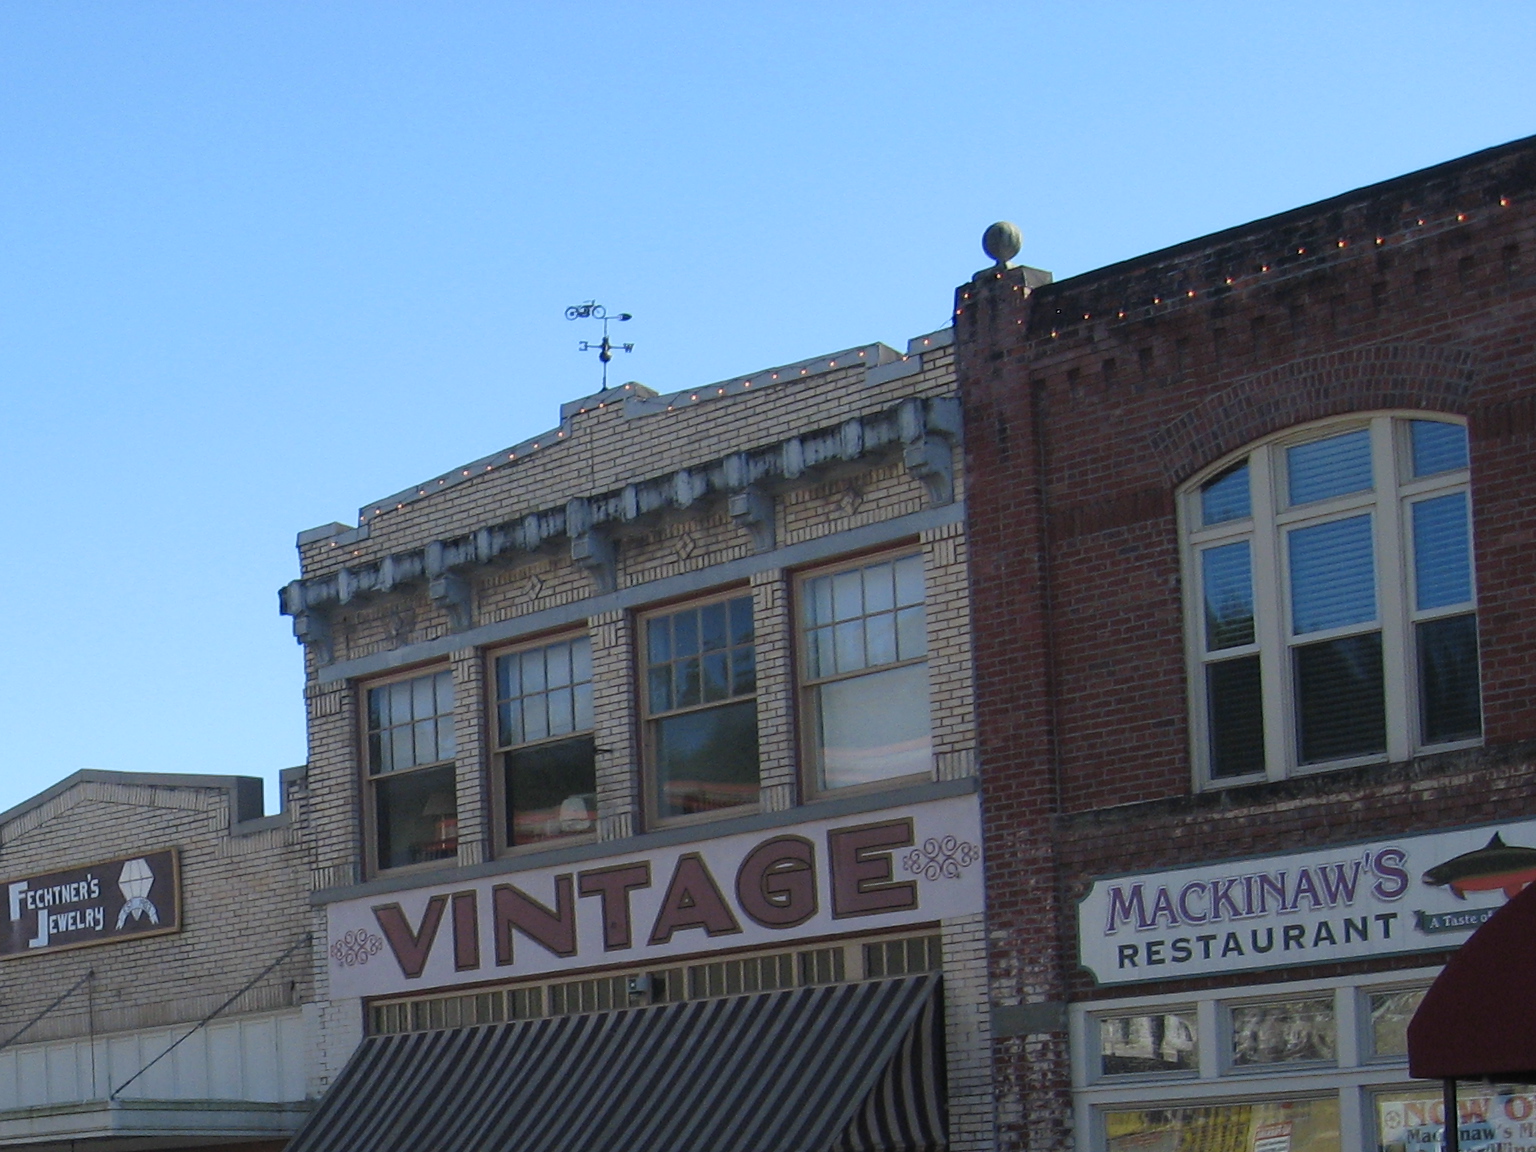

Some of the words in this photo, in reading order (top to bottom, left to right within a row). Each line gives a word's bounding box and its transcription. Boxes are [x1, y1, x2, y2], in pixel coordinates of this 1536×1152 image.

[8, 874, 100, 921] FECHTNER'S
[371, 816, 919, 979] VINTAGE
[1104, 847, 1410, 936] MACKINAW'S
[28, 906, 104, 948] JEWELRY
[1117, 912, 1398, 969] RESTAURANT
[1443, 915, 1478, 927] Taste
[1404, 1098, 1491, 1128] NOW
[1504, 1095, 1536, 1122] O
